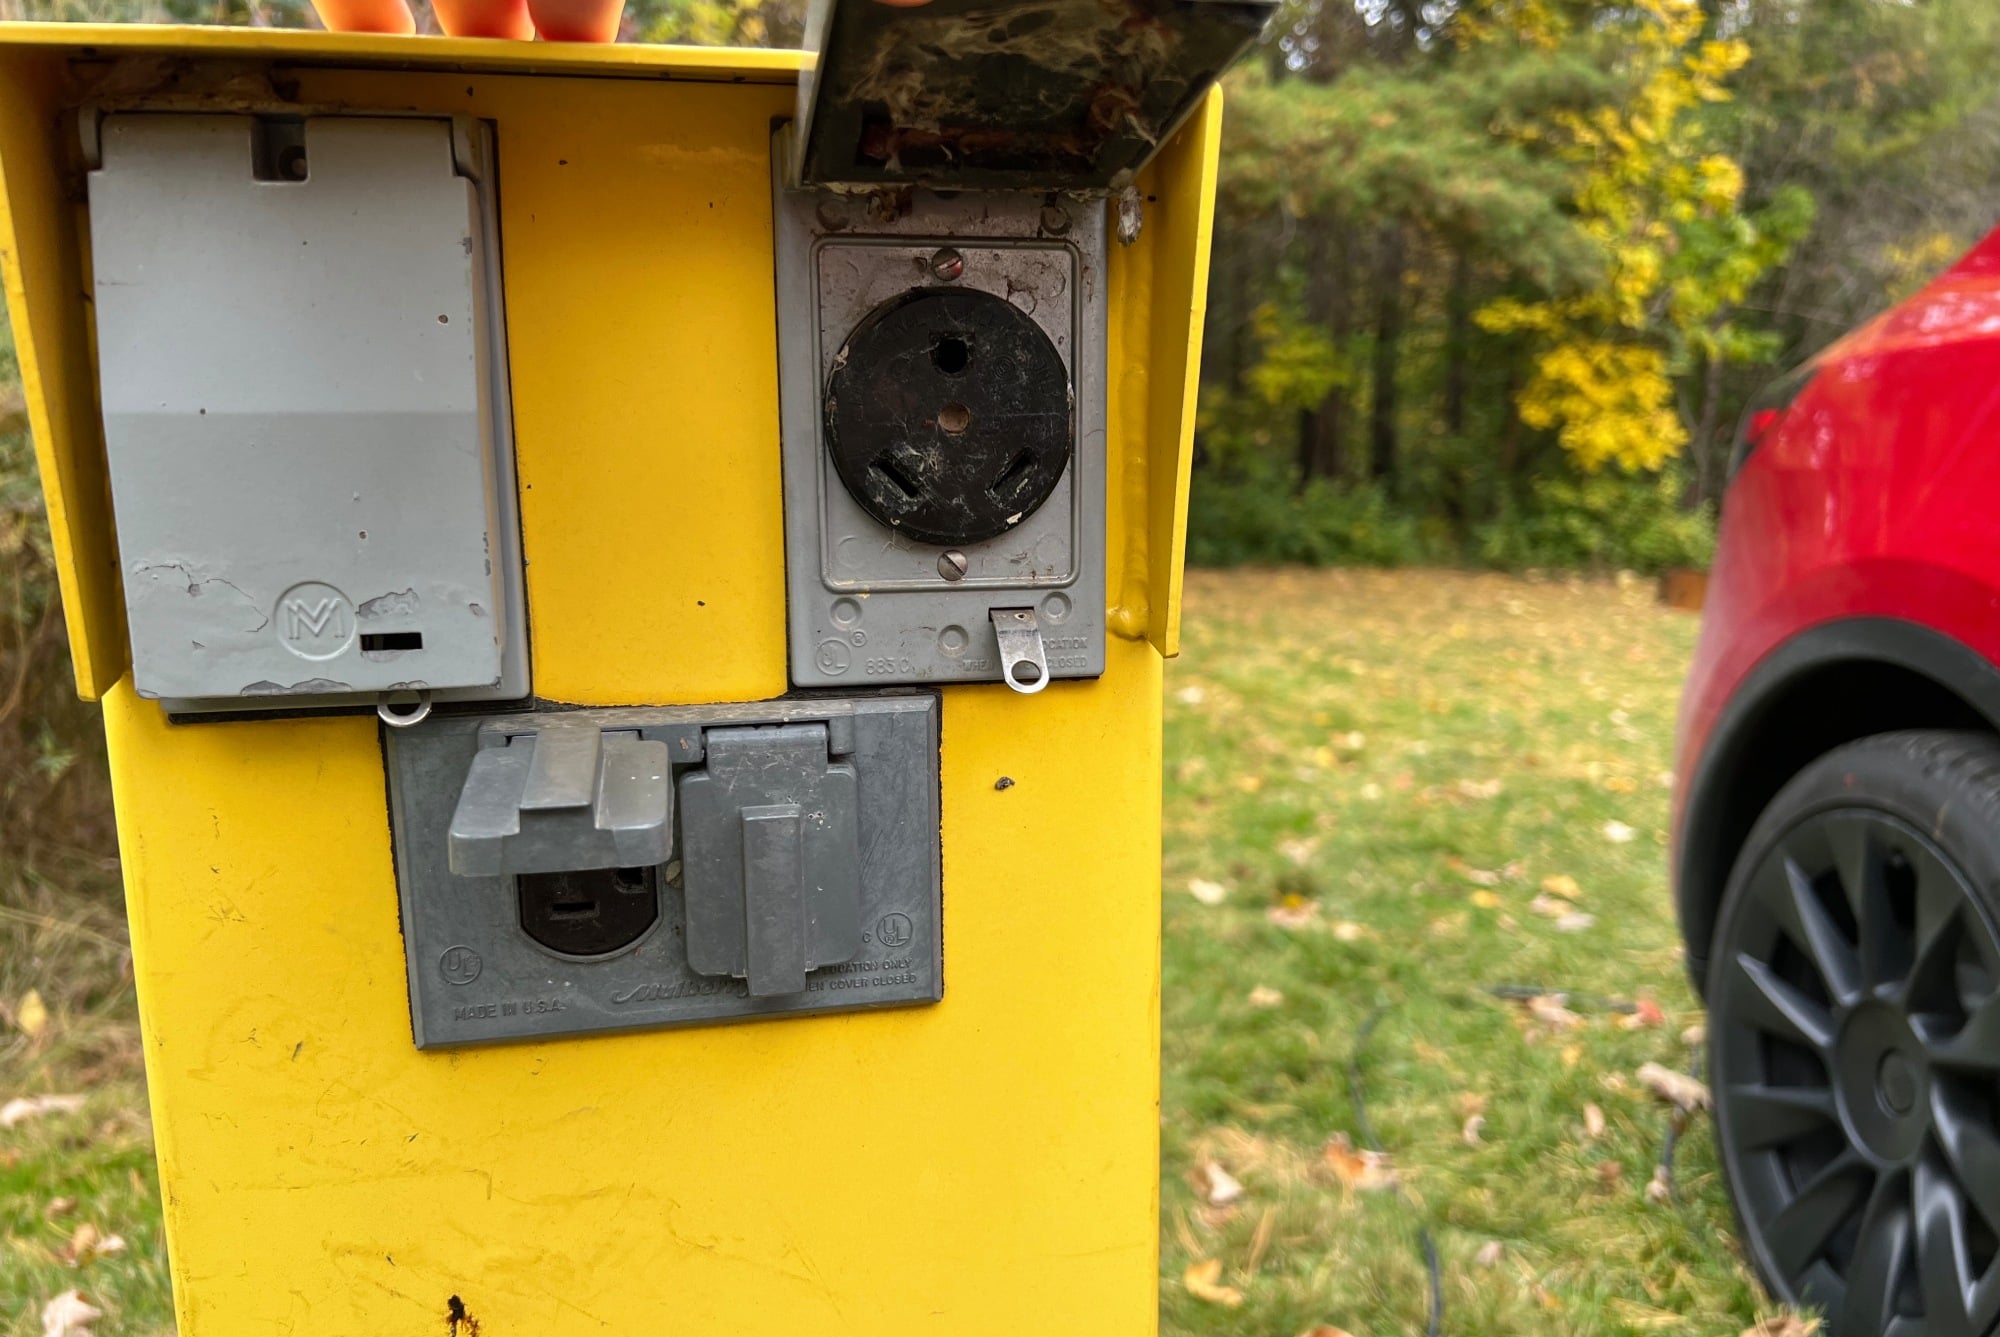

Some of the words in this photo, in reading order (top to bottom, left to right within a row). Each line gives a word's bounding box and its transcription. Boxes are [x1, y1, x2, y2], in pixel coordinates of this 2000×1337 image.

[882, 957, 912, 971] ONLY
[829, 978, 868, 992] COVER
[872, 973, 917, 987] CLOSED
[454, 1003, 497, 1021] MADE
[502, 1001, 518, 1016] IN
